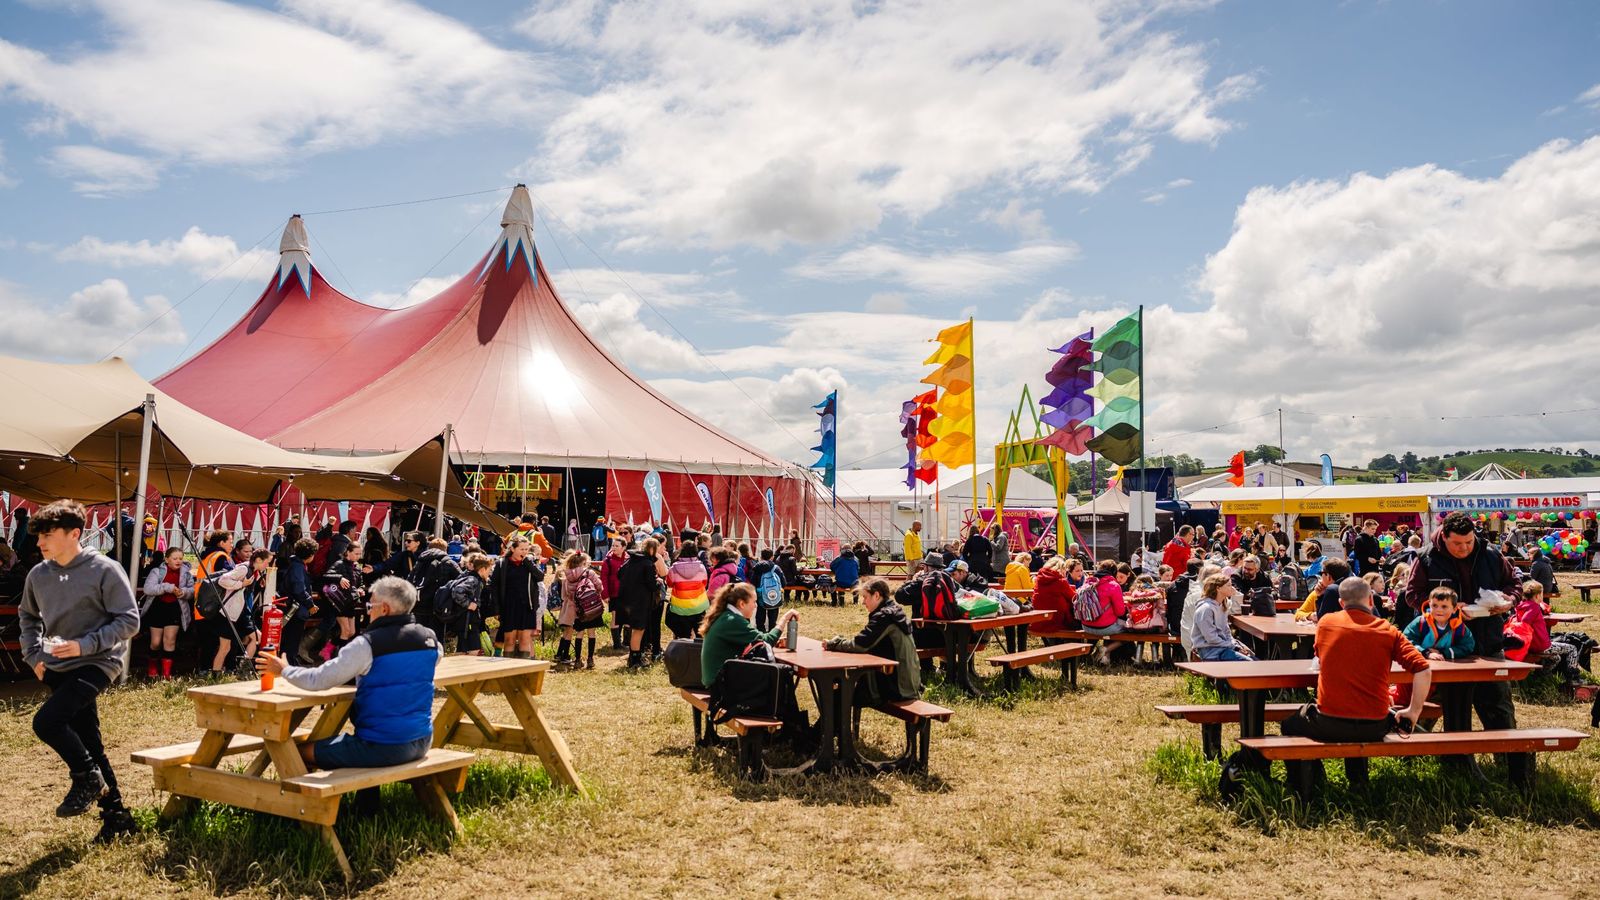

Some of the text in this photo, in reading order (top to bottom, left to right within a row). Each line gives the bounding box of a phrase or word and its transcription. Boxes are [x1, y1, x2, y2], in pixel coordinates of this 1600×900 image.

[463, 471, 550, 491] YR ADLEN
[1437, 496, 1581, 508] HWYL 4 PLANT FUN 4 KIDS
